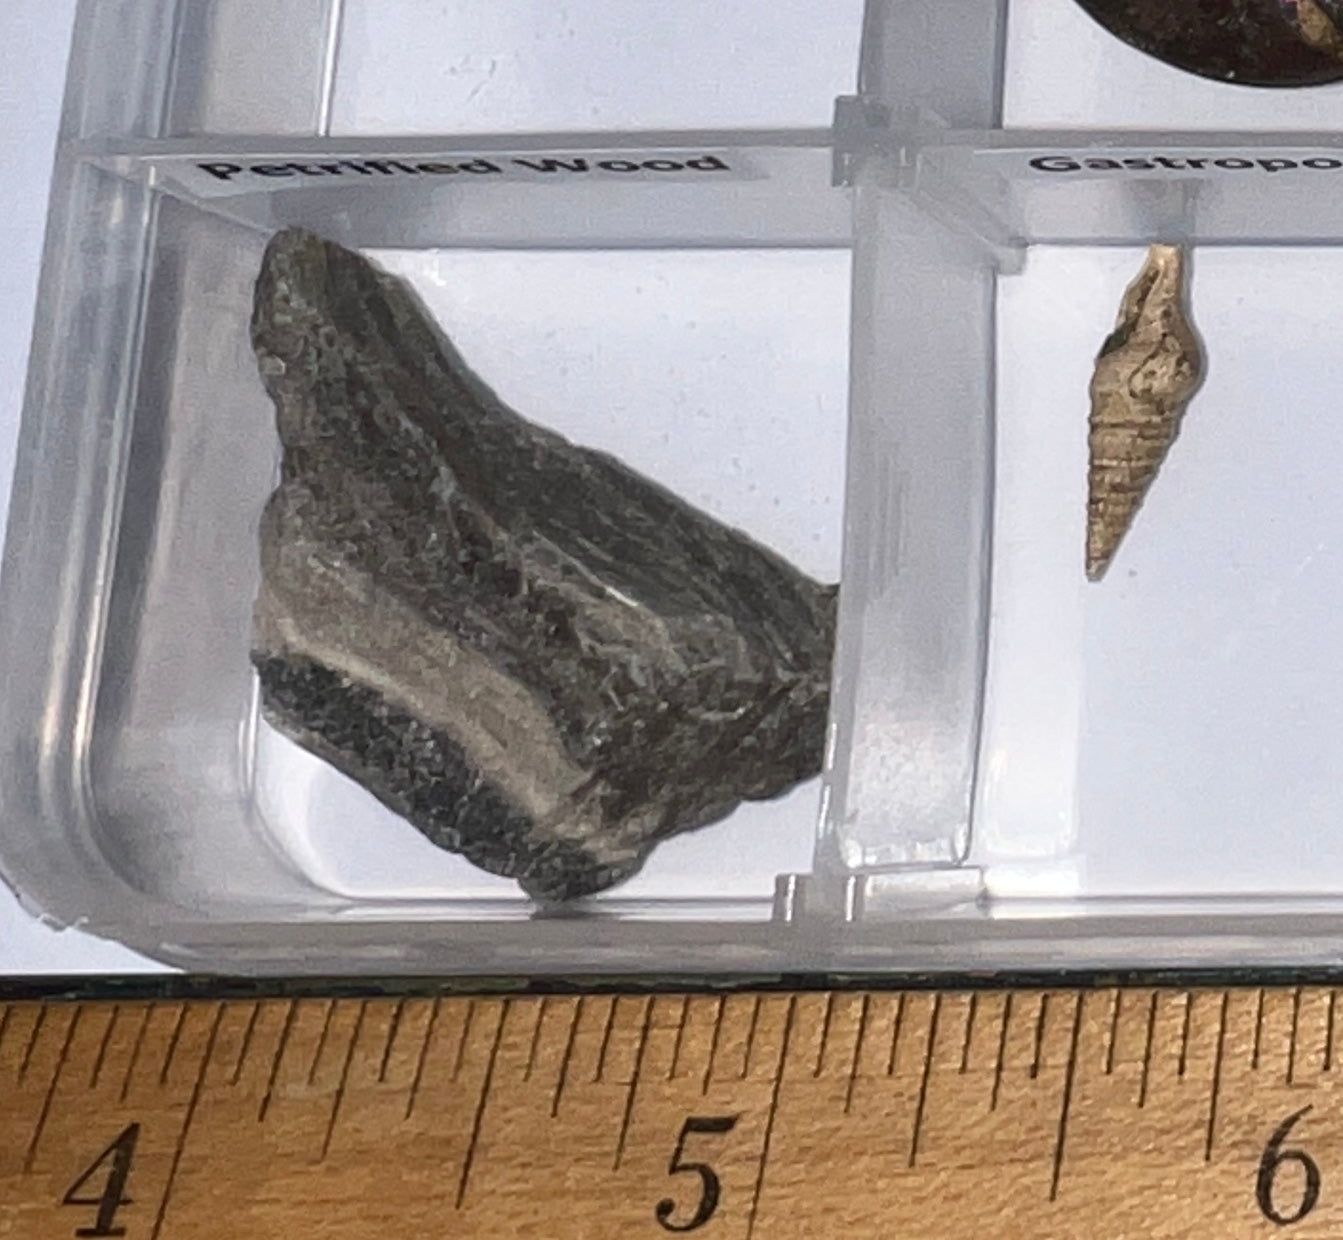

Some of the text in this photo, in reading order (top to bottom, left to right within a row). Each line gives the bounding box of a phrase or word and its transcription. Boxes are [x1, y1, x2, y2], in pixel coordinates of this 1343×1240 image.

[196, 154, 731, 181] Petrified Wood
[60, 1119, 143, 1238] 4
[653, 1113, 742, 1232] 5
[1255, 1103, 1322, 1224] 6
